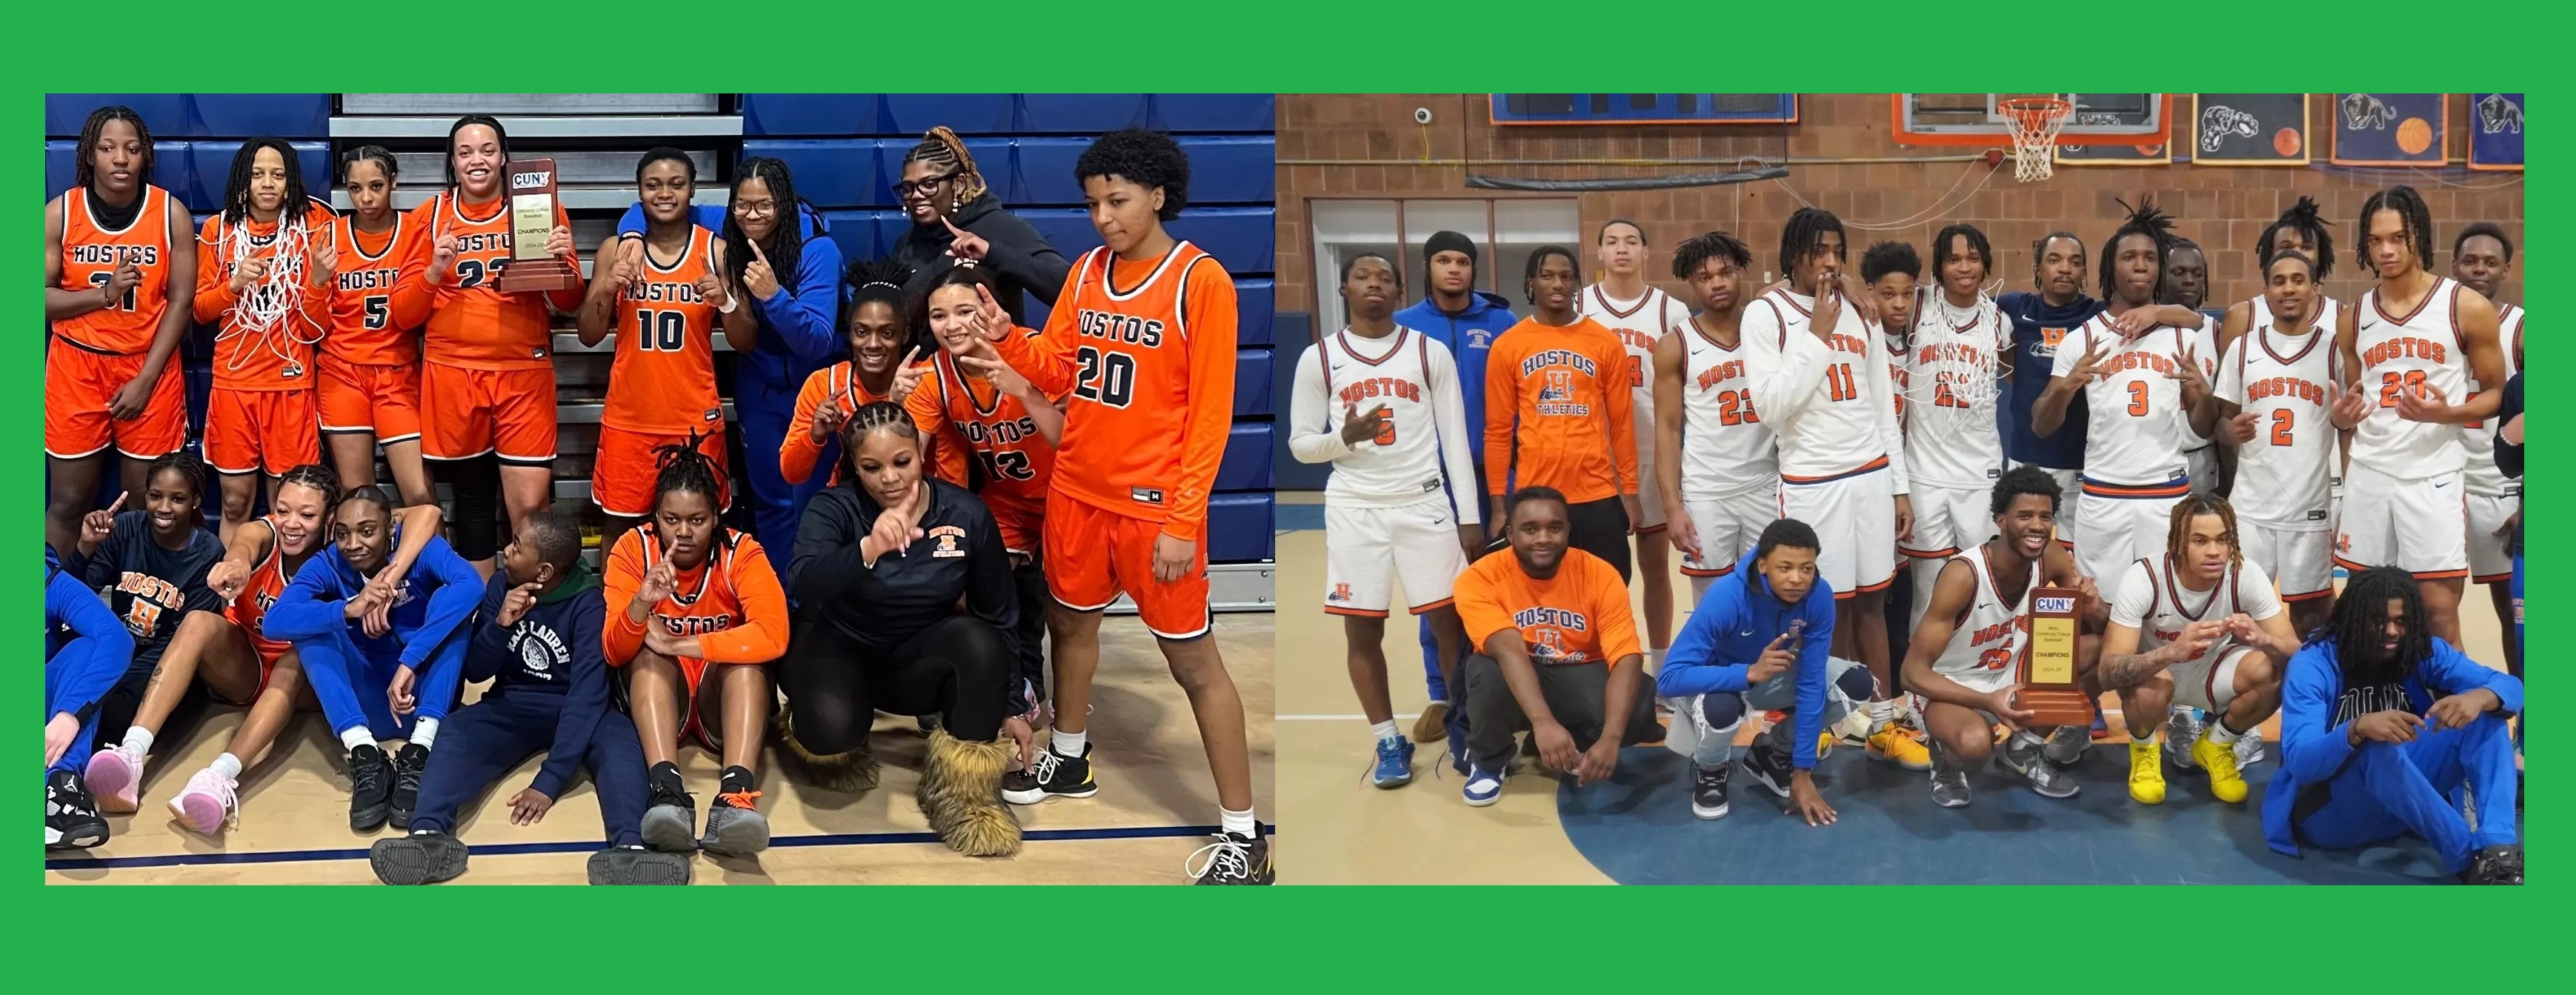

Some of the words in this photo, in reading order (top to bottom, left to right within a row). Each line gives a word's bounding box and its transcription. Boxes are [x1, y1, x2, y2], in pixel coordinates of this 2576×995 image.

[73, 243, 158, 267] HOSTOS
[363, 294, 390, 330] 5
[636, 308, 686, 352] 10
[1522, 348, 1596, 380] HOSTOS
[2100, 350, 2175, 383] HOSTOS
[2362, 336, 2446, 372] HOSTOS
[1072, 345, 1136, 410] 20
[1339, 377, 1420, 410] HOSTOS
[1826, 362, 1857, 402] 11
[2246, 376, 2325, 407] HOSTOS
[2380, 369, 2428, 409] 20
[1536, 403, 1589, 416] THLETICS
[1717, 387, 1760, 427] 23
[2127, 380, 2149, 417] 3
[953, 416, 1038, 446] HOSTOS
[2271, 407, 2294, 447] 2
[976, 448, 1036, 483] 12
[115, 570, 185, 612] HOSTOS
[2036, 597, 2076, 610] CUNY
[1514, 605, 1585, 632] HOSTOS
[530, 620, 570, 665] LAUREN
